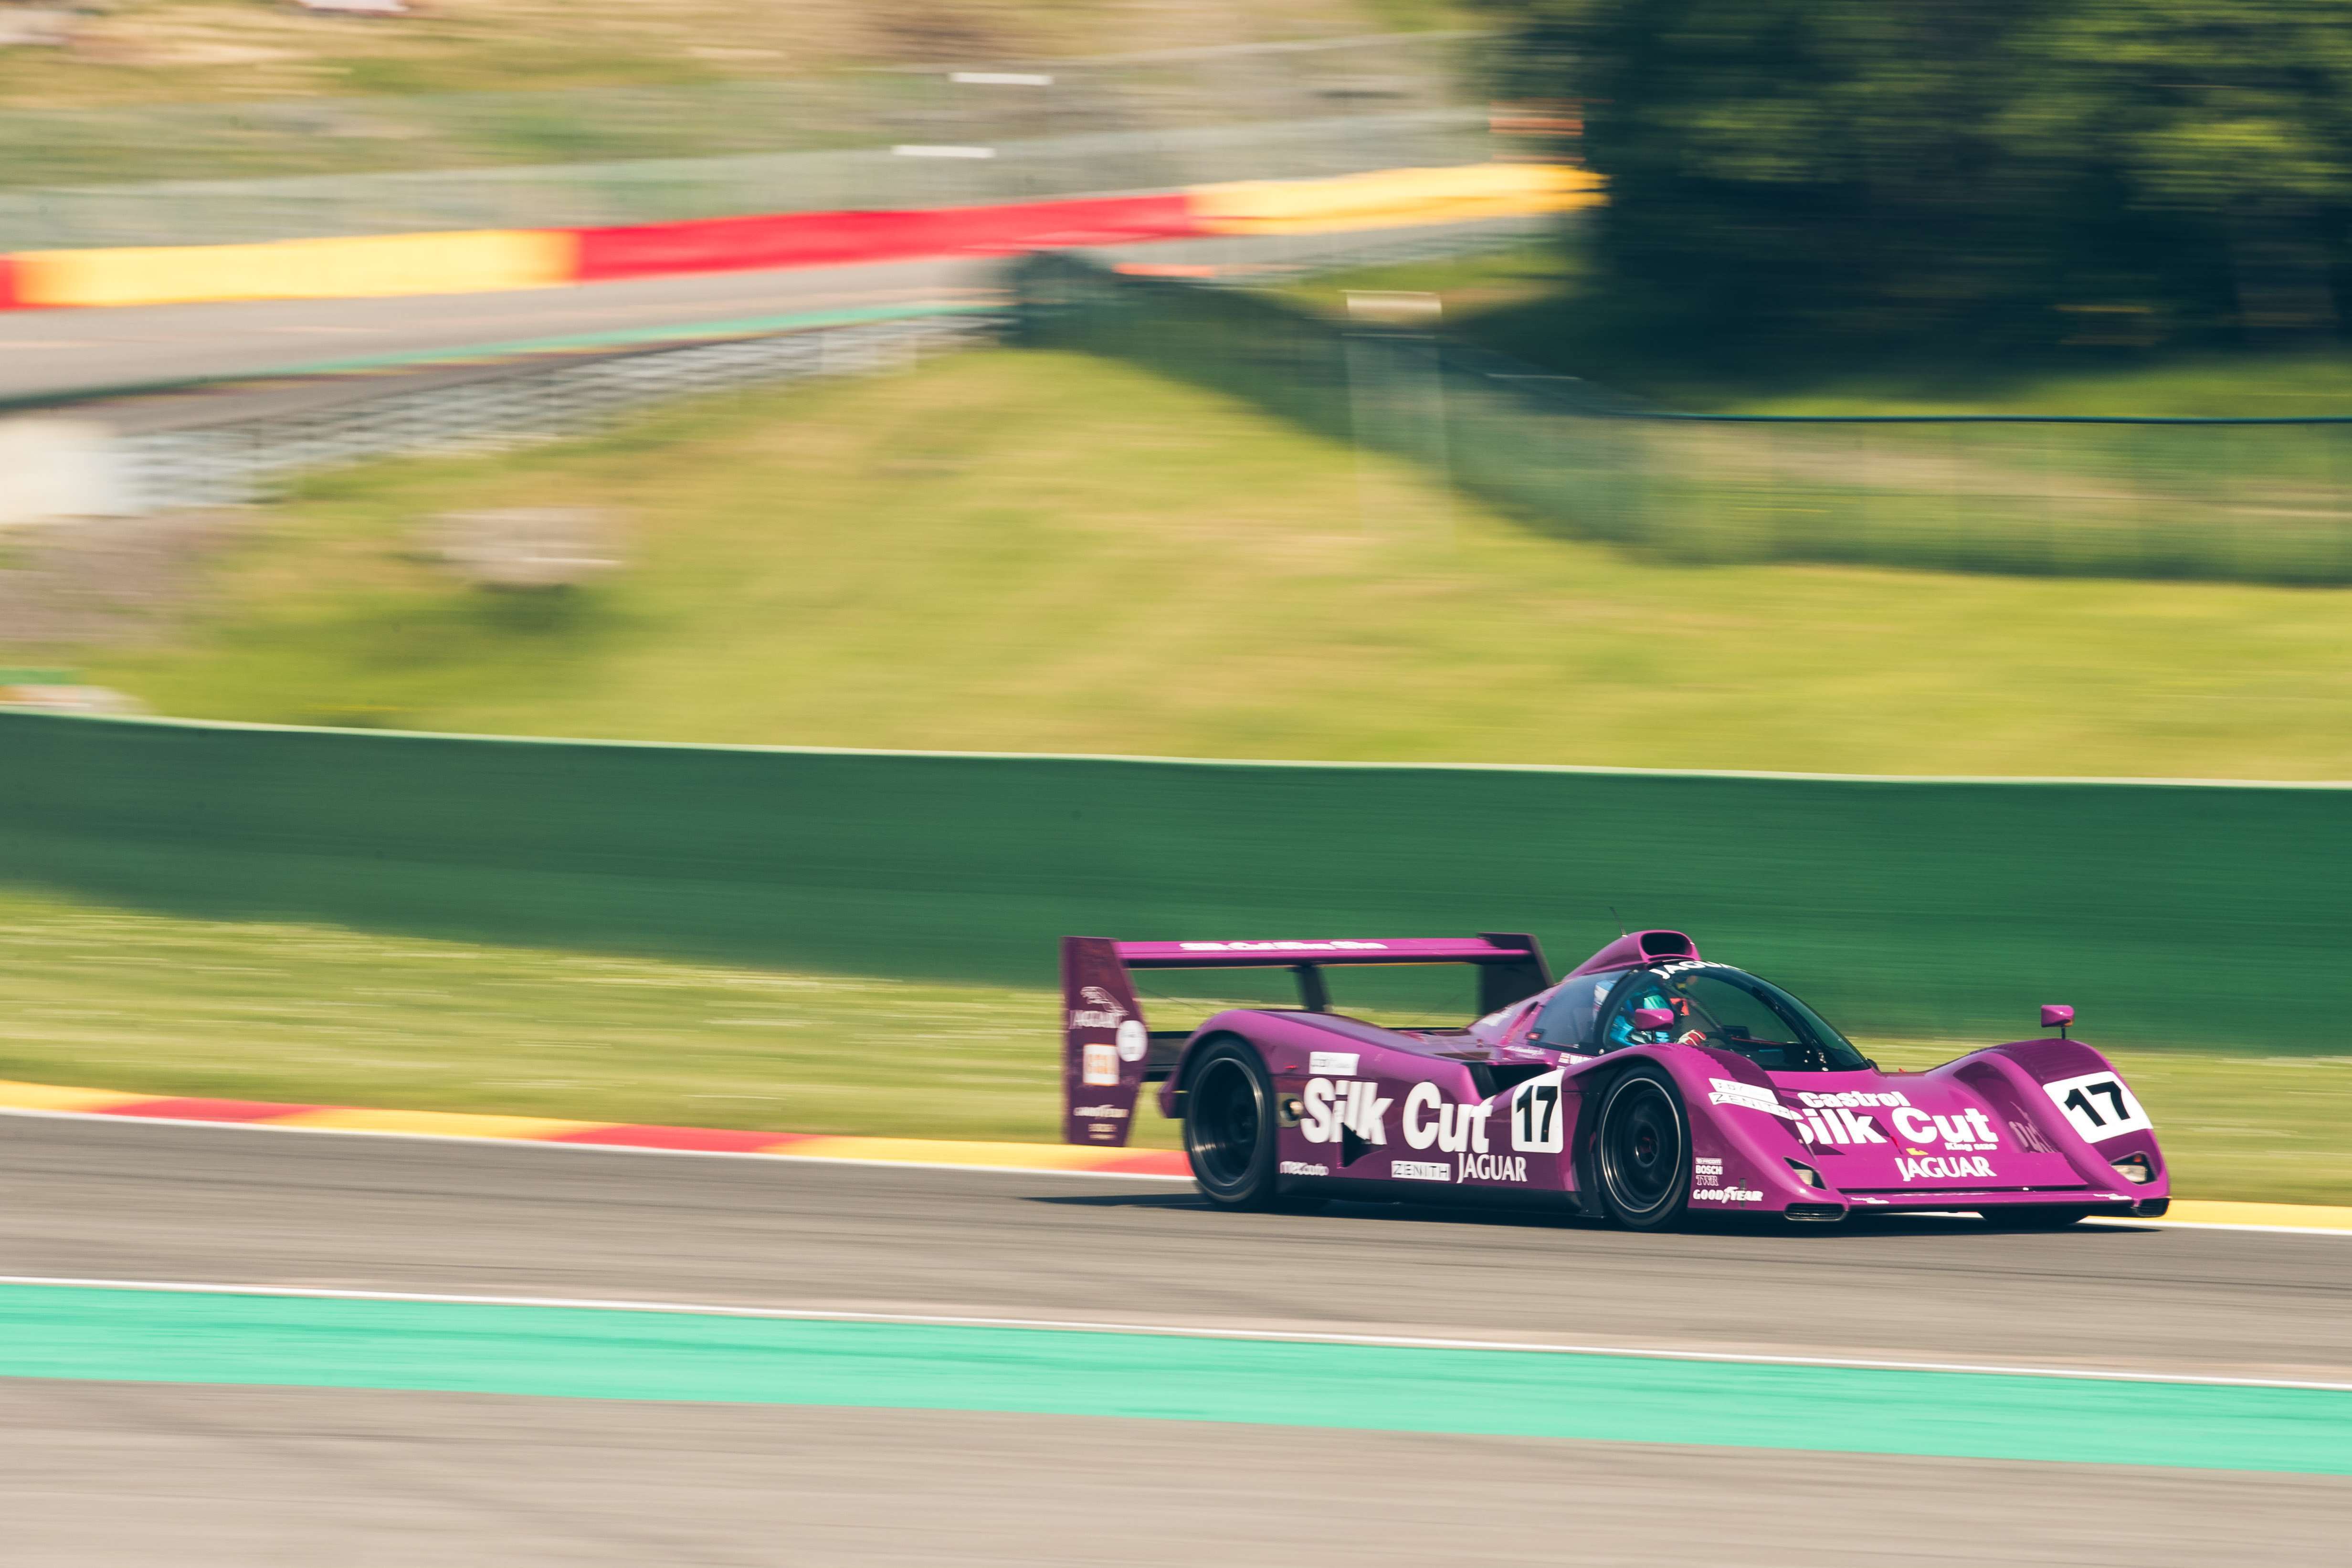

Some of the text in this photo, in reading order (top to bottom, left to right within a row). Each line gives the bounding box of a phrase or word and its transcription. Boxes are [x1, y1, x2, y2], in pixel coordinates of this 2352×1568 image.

[1649, 960, 1748, 979] JAGU
[1712, 1093, 1792, 1117] ZENITH
[1797, 1091, 1911, 1108] Castrol
[2064, 1080, 2131, 1127] 17
[1301, 1077, 1493, 1154] Silk Cut
[1516, 1085, 1558, 1143] 17
[1891, 1107, 1999, 1144] Cut
[1394, 1163, 1449, 1178] ZENITH
[1456, 1153, 1528, 1183] JAGUAR
[1696, 1165, 1723, 1175] BOSCH
[1894, 1156, 1998, 1182] JAGUAR
[1696, 1175, 1719, 1186] TWR
[1693, 1187, 1763, 1204] GOODYEAR
